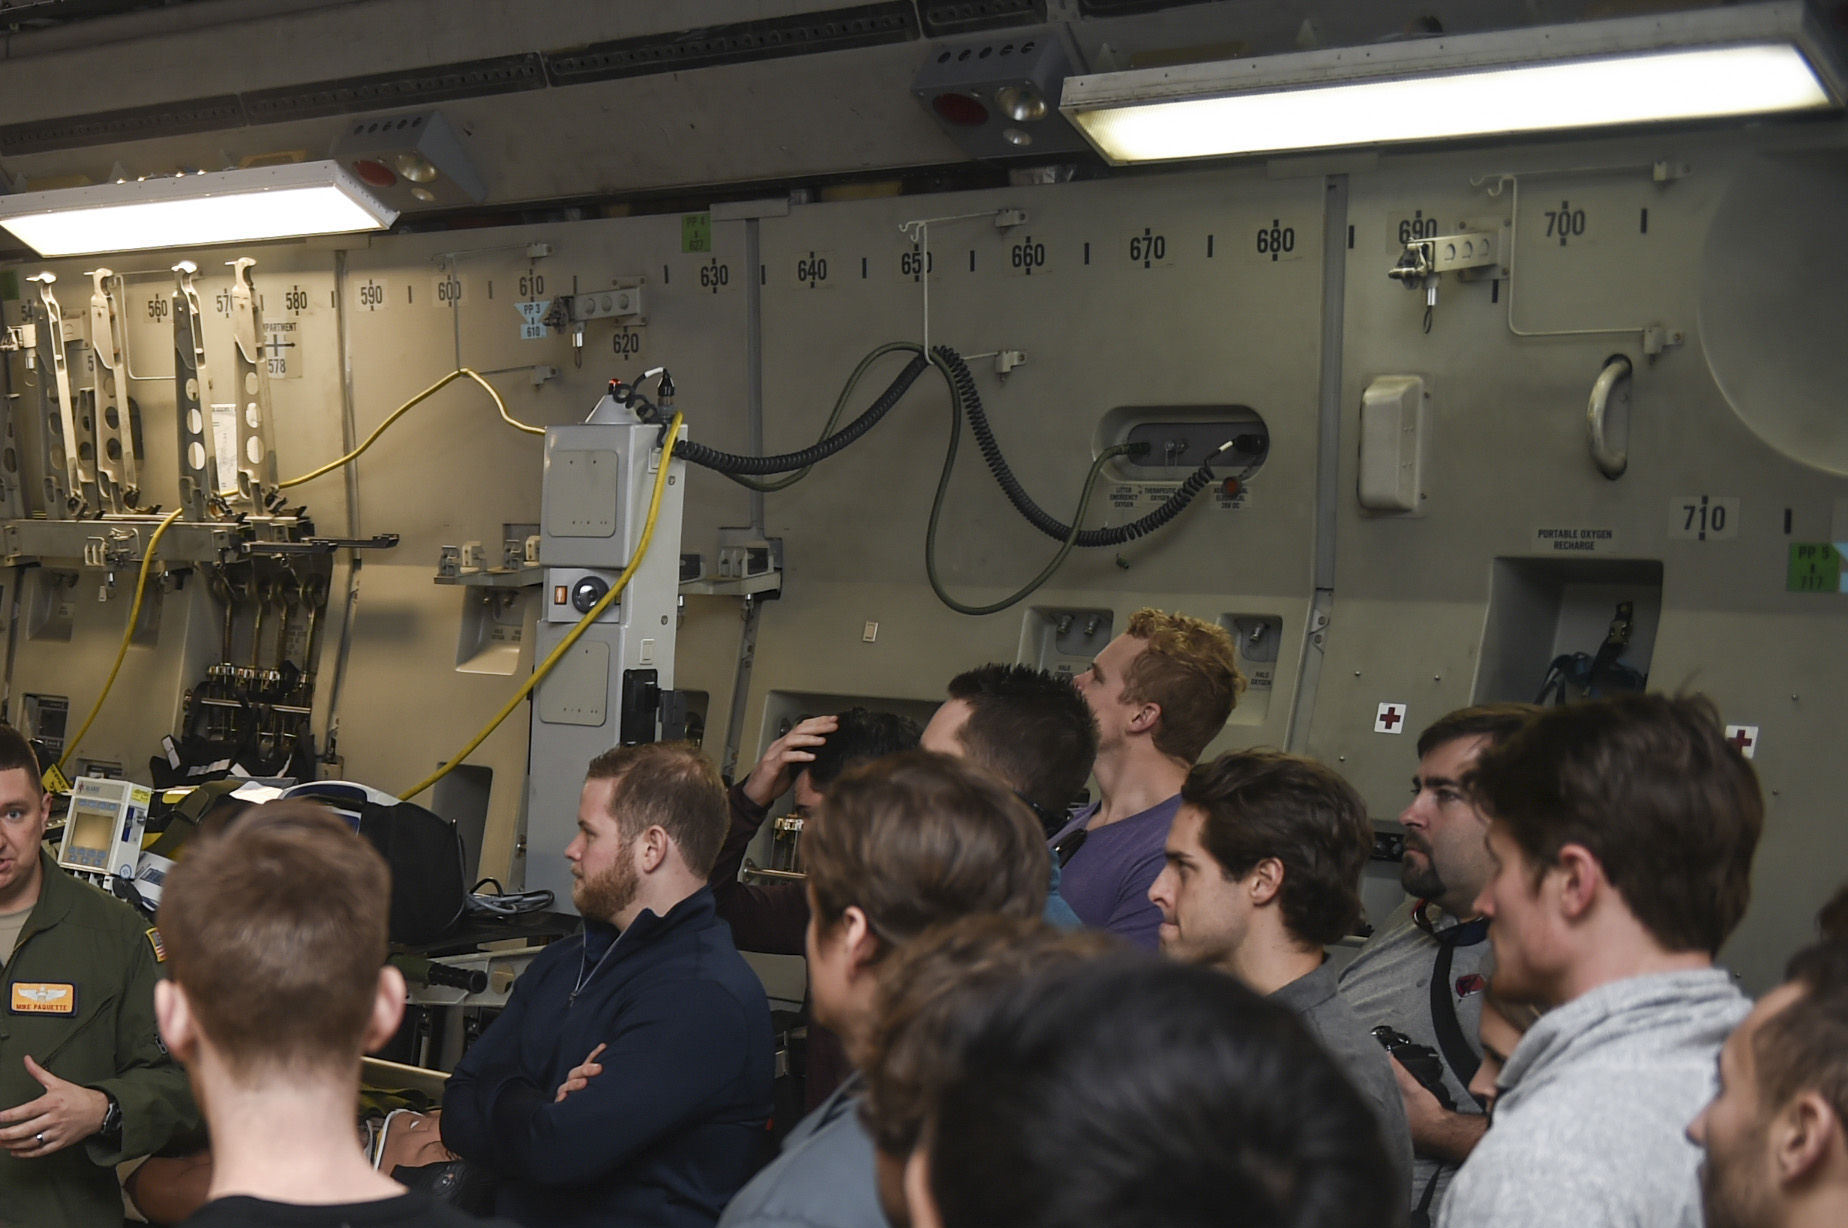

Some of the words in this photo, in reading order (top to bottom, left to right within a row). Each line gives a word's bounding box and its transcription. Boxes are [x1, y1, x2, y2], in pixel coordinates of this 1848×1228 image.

[1399, 218, 1438, 244] 690
[1544, 210, 1585, 238] 700
[1129, 235, 1166, 261] 670
[1256, 227, 1295, 254] 680
[902, 251, 932, 275] 650
[1012, 243, 1045, 268] 660
[700, 264, 728, 287] 630
[798, 258, 827, 281] 640
[360, 285, 383, 305] 590
[438, 280, 461, 301] 600
[519, 275, 544, 296] 610
[148, 301, 168, 317] 560
[216, 294, 233, 312] 57
[285, 291, 308, 310] 580
[524, 304, 533, 314] PP
[536, 303, 541, 314] 3
[21, 305, 34, 321] 54
[263, 322, 297, 332] PARTMENT
[527, 327, 540, 337] 610
[613, 333, 639, 354] 620
[268, 359, 286, 373] 578
[1683, 505, 1726, 531] 710
[1537, 529, 1578, 539] PORTABLE
[1580, 529, 1613, 539] OXYGEN
[1553, 541, 1595, 551] RECHARGE
